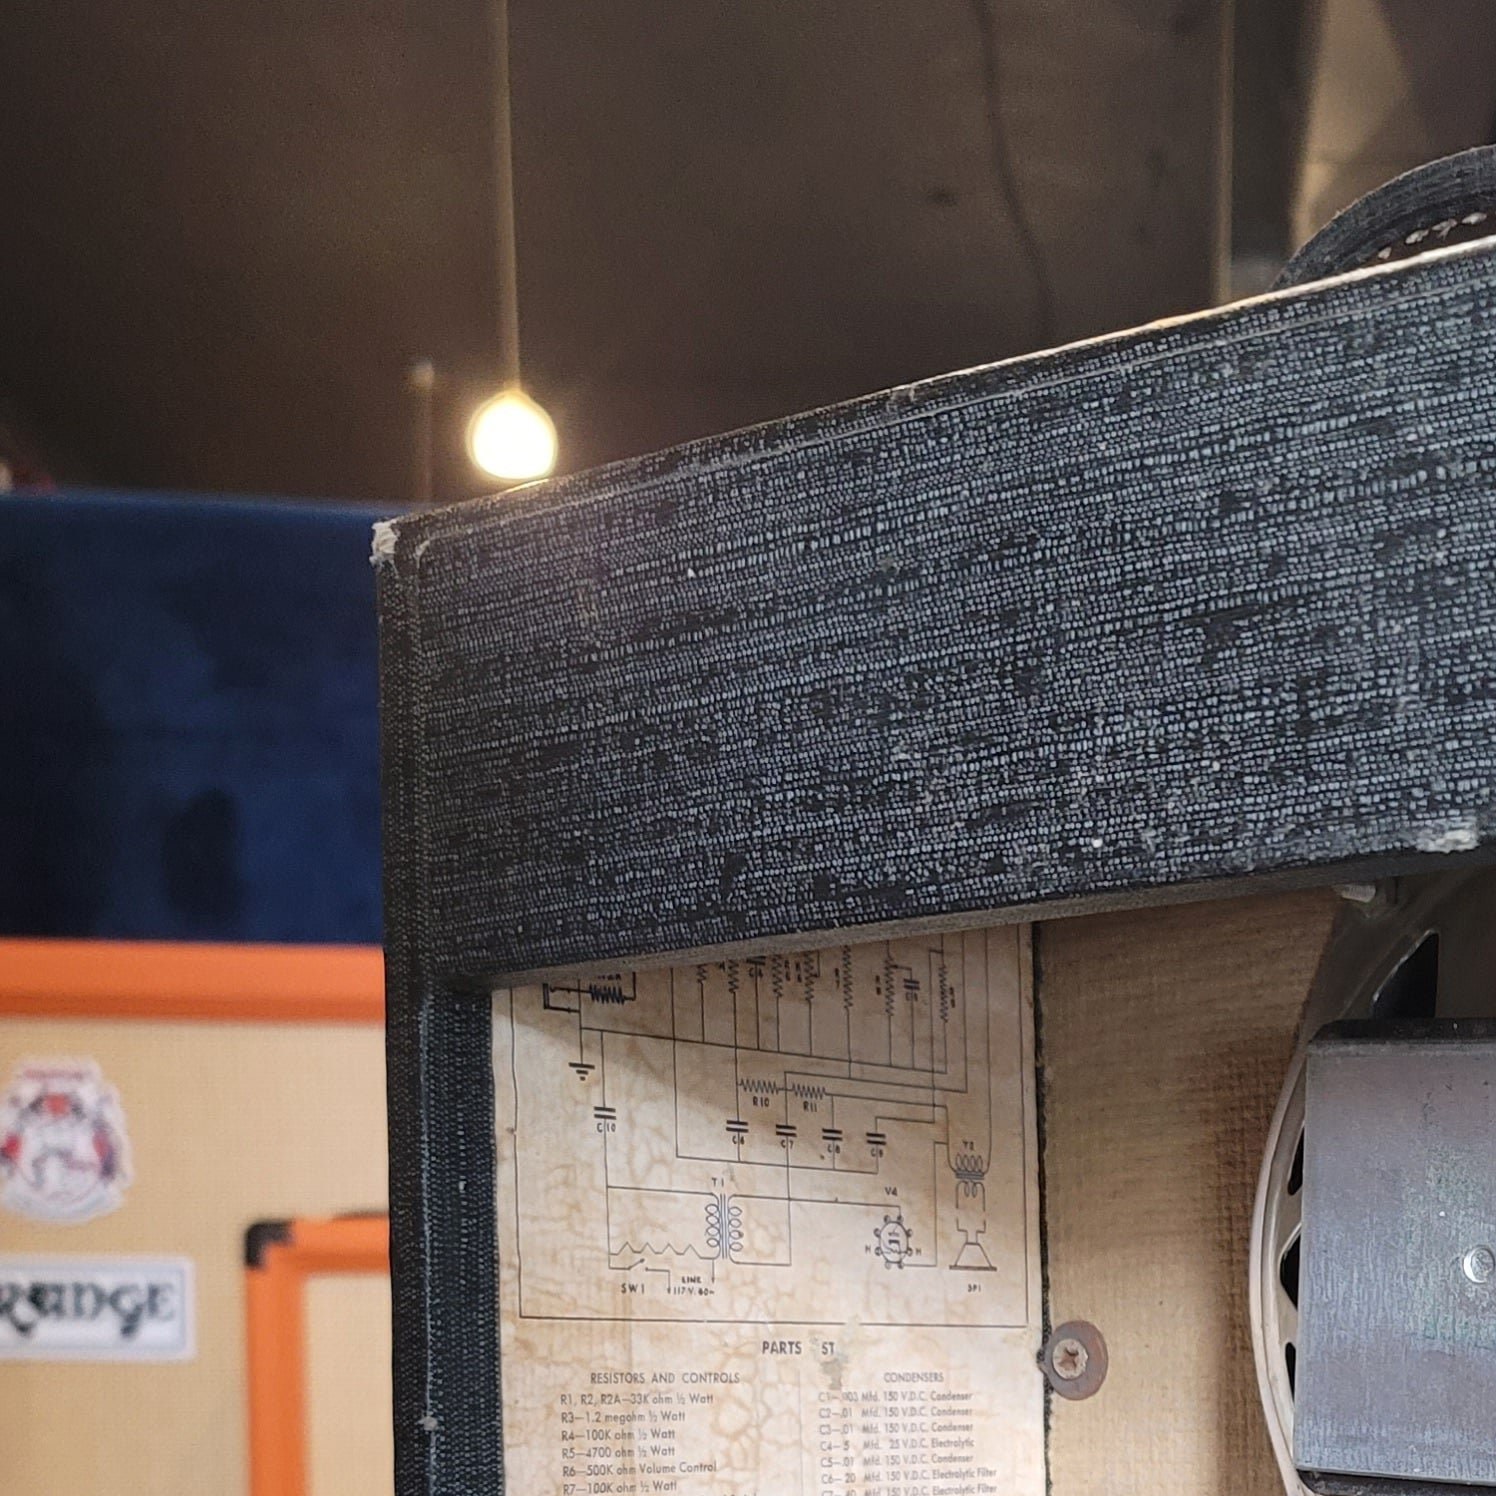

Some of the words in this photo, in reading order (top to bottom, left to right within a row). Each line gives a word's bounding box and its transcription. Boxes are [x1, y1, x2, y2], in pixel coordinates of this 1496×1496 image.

[753, 1098, 769, 1108] R10
[803, 1102, 817, 1112] R11
[597, 1123, 616, 1133] C10
[885, 1187, 897, 1195] V4
[762, 1341, 802, 1354] PARTS
[590, 1373, 645, 1383] RESISTORS
[651, 1373, 675, 1383] AND
[682, 1373, 739, 1383] CONTROLS
[884, 1372, 944, 1382] CONDENSERS
[652, 1393, 672, 1404] ohm
[690, 1394, 713, 1404] Watt
[930, 1392, 972, 1400] Condenser
[931, 1408, 972, 1416] Condenser
[605, 1410, 645, 1425] megohm
[661, 1411, 685, 1422] Watt
[931, 1423, 972, 1432] Condenser
[615, 1429, 634, 1440] ohm
[651, 1429, 675, 1439] Watt
[931, 1438, 974, 1448] Electrolytic
[615, 1447, 634, 1458] ohm
[651, 1446, 675, 1456] Watt
[932, 1454, 973, 1463] Condenser
[617, 1464, 635, 1475] ohm
[639, 1463, 676, 1474] Volume
[679, 1461, 716, 1472] Control
[933, 1470, 975, 1480] Electrolytic
[978, 1468, 996, 1478] Filter
[617, 1482, 636, 1492] ohm
[653, 1481, 677, 1491] Watt
[933, 1486, 975, 1496] Electrolytic
[978, 1485, 997, 1494] Filter
